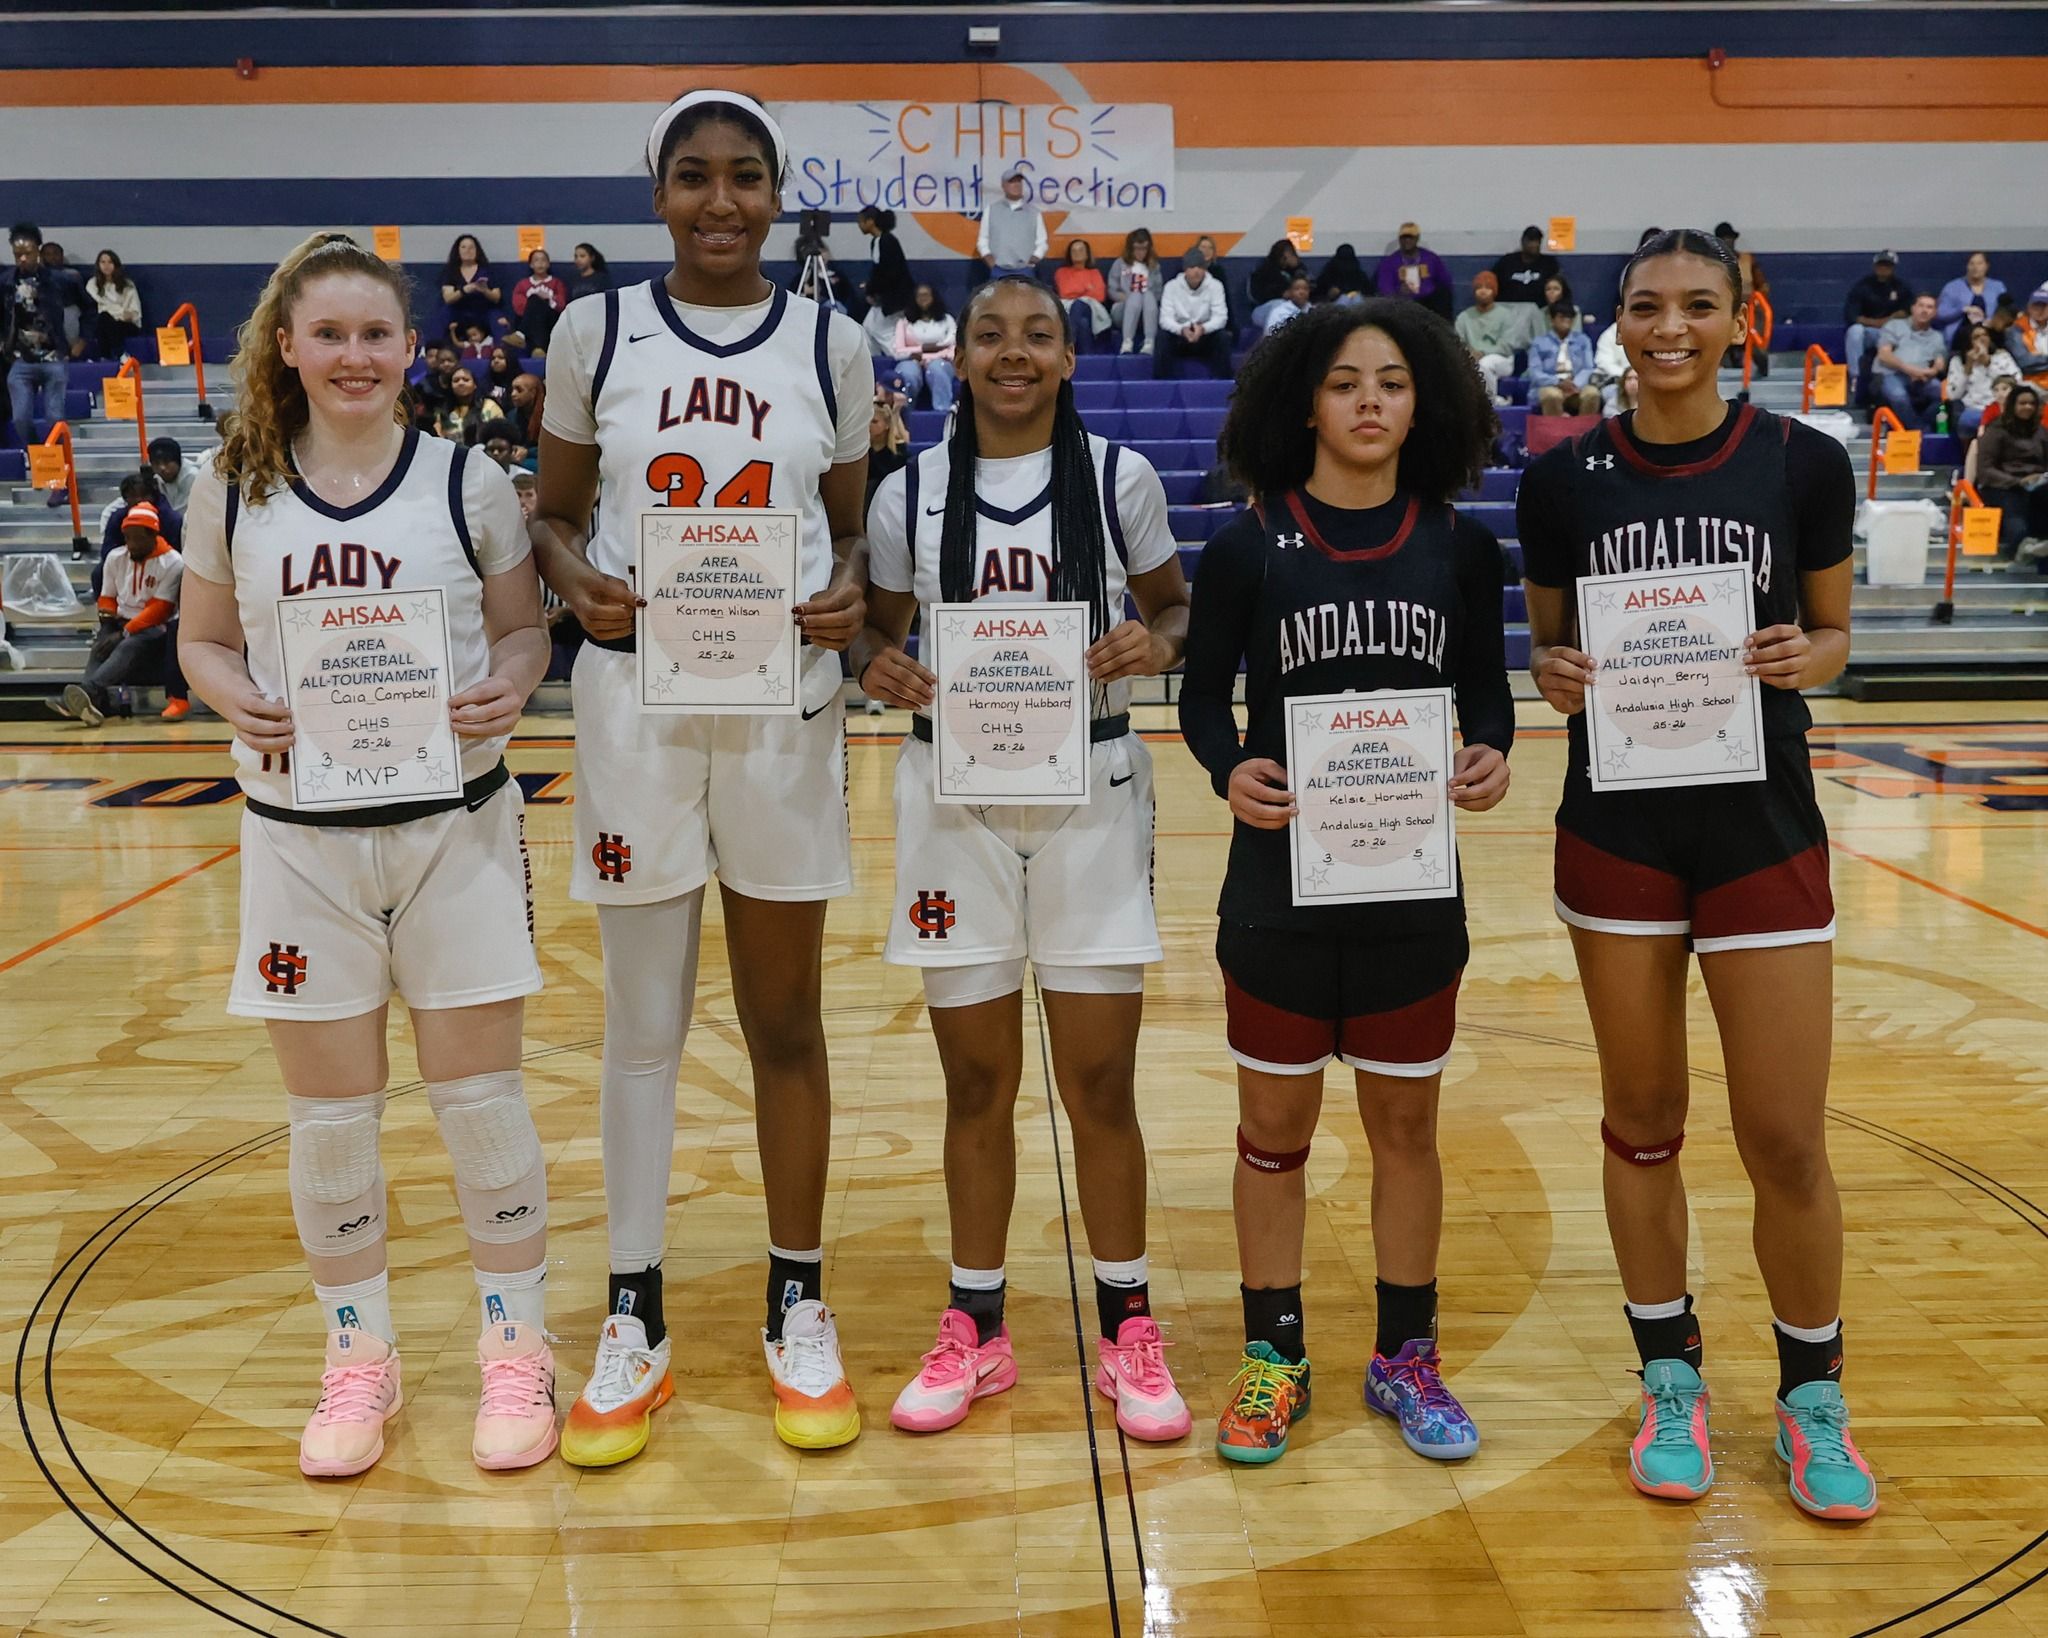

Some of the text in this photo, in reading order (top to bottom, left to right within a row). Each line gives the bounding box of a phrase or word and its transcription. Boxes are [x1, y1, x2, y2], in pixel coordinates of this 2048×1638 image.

[898, 105, 1082, 159] CHHS
[797, 155, 983, 209] Student
[658, 376, 772, 442] LADY
[680, 524, 759, 543] AHSAA
[701, 556, 738, 568] AREA
[1589, 517, 1772, 594] ANDALUSIA
[282, 543, 402, 597] LADY
[971, 547, 1057, 601] ADY
[676, 572, 763, 584] BASKETBALL
[655, 587, 785, 600] ALL-TOURNAMENT
[1624, 584, 1706, 610] AHSAA
[321, 604, 405, 628] AHSAA
[676, 605, 760, 616] Karmen Wilson
[973, 619, 1048, 638] AHSAA
[1647, 619, 1687, 633] AREA
[692, 630, 736, 642] CHHS
[1280, 600, 1446, 675] ANDALUSIA
[1623, 633, 1715, 653] BASKETBALL
[346, 639, 386, 653] AREA
[321, 653, 414, 671] BASKETBALL
[993, 650, 1029, 662] AREA
[1602, 647, 1740, 671] ALL-TOURNAMENT
[670, 662, 680, 673] 3
[758, 664, 768, 673] 5
[969, 666, 1053, 678] BASKETBALL
[300, 667, 439, 689] ALL-TOURNAMENT
[1619, 671, 1709, 688] Jaidyn Berry
[949, 680, 1075, 693] ALL-TOURNAMENT
[330, 685, 436, 705] Caia Campbell
[969, 697, 1072, 715] Harmony Hubbard
[1615, 695, 1735, 714] Andalusia High School
[347, 717, 389, 731] CHHS
[1330, 708, 1408, 730] AHSAA
[981, 723, 1024, 734] CHHS
[1716, 729, 1726, 739] 5
[352, 737, 392, 749] 25-26
[1351, 742, 1389, 754] AREA
[1624, 736, 1633, 746] 3
[321, 752, 333, 767] 3
[416, 747, 428, 759] 5
[967, 755, 976, 764] 3
[1048, 755, 1057, 764] 5
[1328, 756, 1415, 772] BASKETBALL
[346, 766, 398, 787] MVP
[1306, 770, 1438, 789] ALL-TOURNAMENT
[1329, 795, 1366, 806] Kelsie
[1320, 814, 1435, 832] Andalusia High School
[1322, 853, 1332, 863] 3
[1413, 849, 1423, 858] 5
